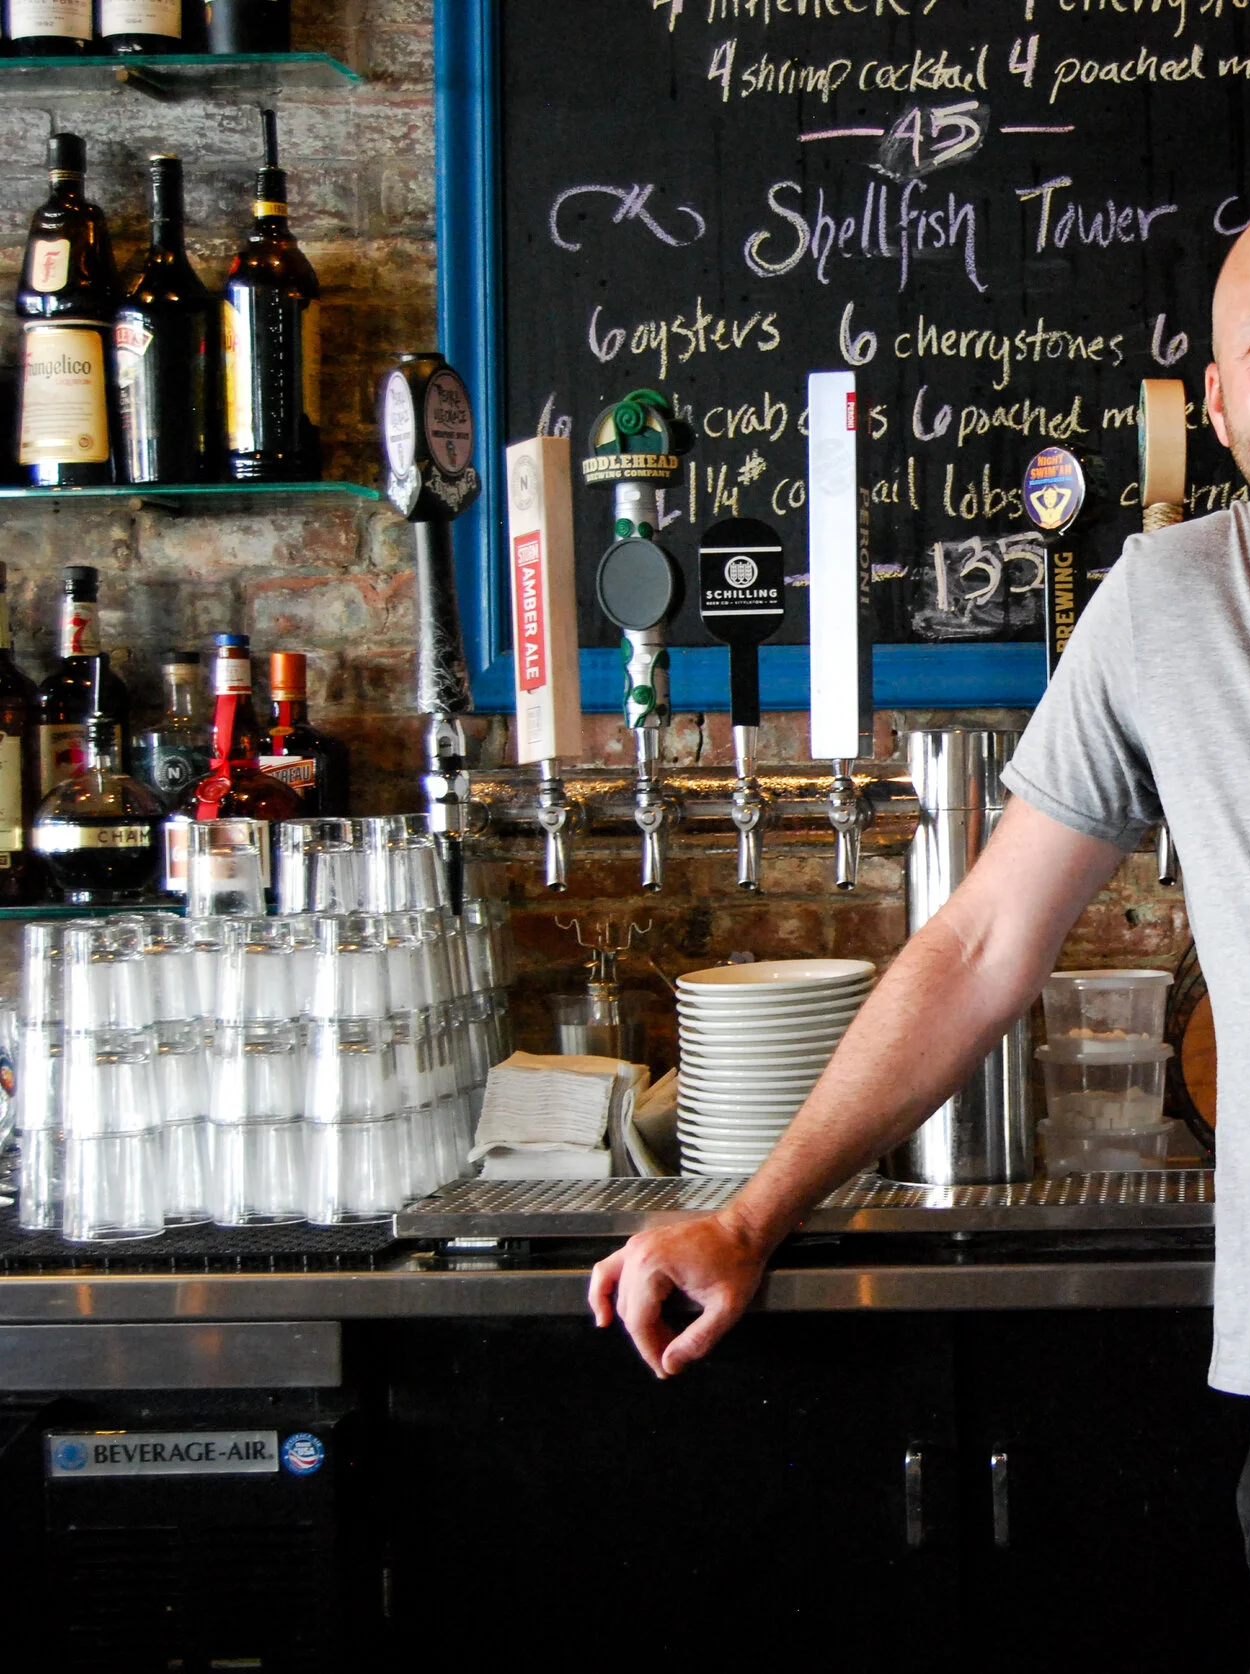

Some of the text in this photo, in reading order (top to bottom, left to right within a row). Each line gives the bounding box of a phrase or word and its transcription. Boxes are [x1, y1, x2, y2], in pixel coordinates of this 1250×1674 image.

[708, 38, 738, 101] 4
[740, 52, 852, 102] shrimp
[858, 44, 989, 93] cocktail
[1008, 34, 1040, 88] 4
[1048, 44, 1206, 104] poached
[893, 100, 981, 166] 45
[743, 175, 1178, 293] Shellfish Tower
[588, 296, 1189, 390] 6 oysters 6 cherrystones 6
[703, 391, 788, 442] crab
[912, 384, 953, 441] 6
[957, 395, 1091, 447] poached
[623, 468, 672, 478] COMPANY
[858, 486, 871, 606] PERONI
[519, 566, 540, 681] AMBER ALE
[705, 588, 778, 600] SCHILLING
